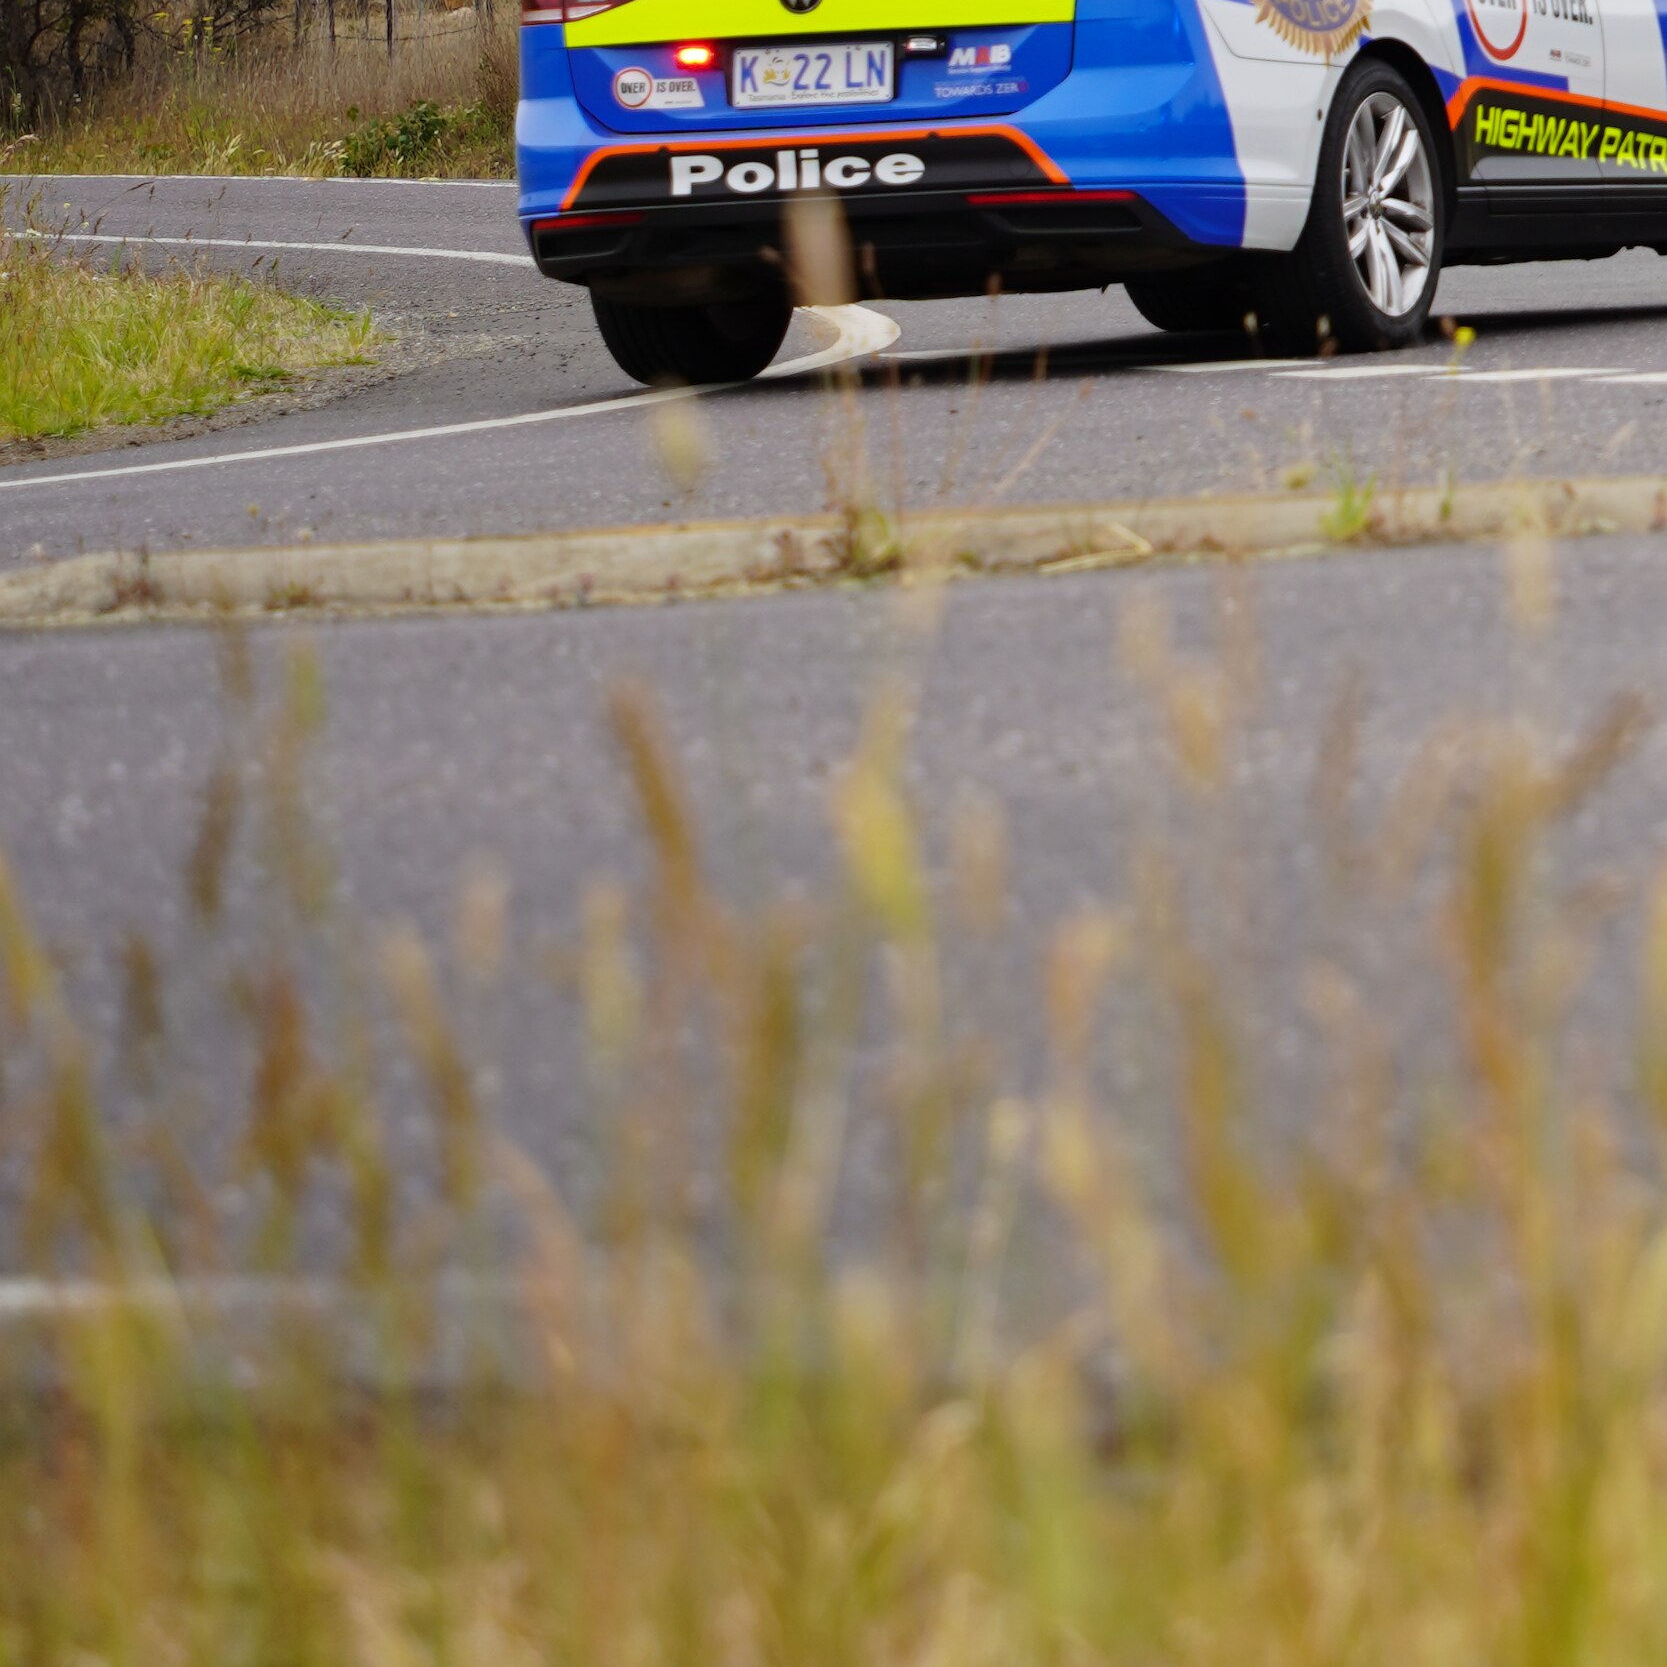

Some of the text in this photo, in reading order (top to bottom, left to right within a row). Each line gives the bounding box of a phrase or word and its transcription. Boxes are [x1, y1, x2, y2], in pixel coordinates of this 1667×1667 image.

[621, 82, 646, 94] OVER
[656, 82, 666, 93] IS
[740, 49, 886, 93] K 22 LN
[934, 84, 993, 97] TOWARDS
[1475, 104, 1600, 160] HIGHWAY
[671, 148, 925, 196] Police
